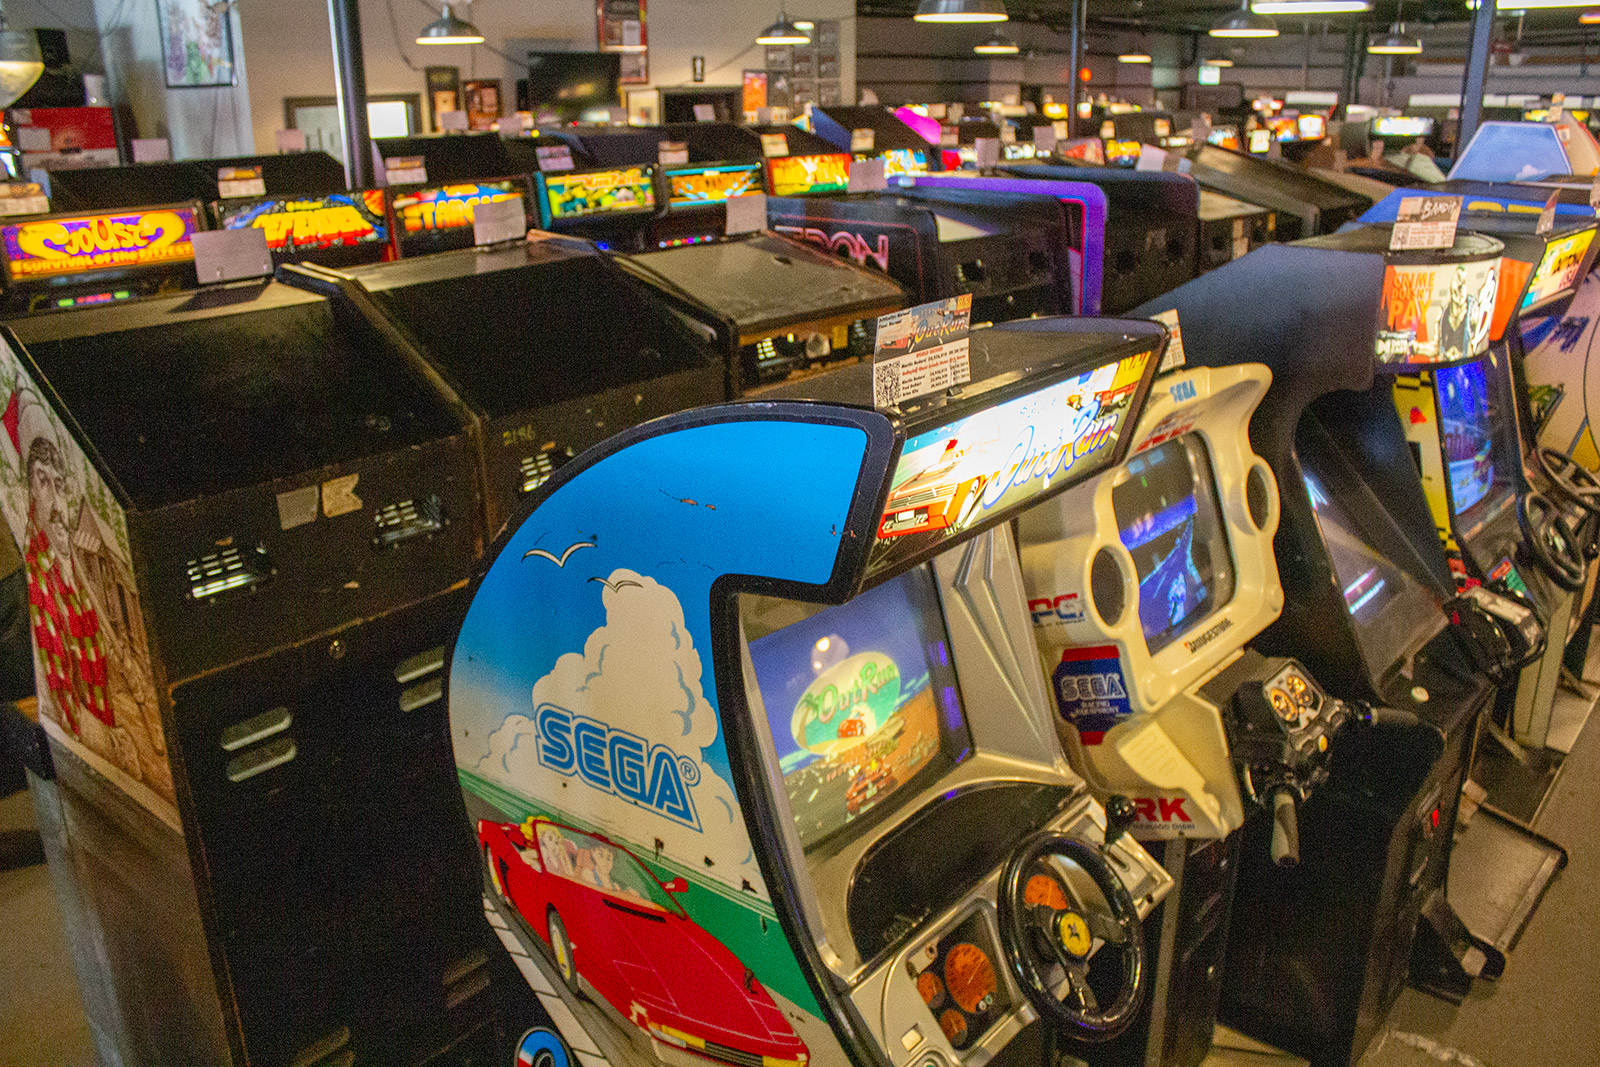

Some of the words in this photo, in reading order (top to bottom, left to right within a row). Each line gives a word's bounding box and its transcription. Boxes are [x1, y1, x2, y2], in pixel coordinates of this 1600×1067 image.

[21, 254, 94, 272] SURVIVAL
[1388, 299, 1431, 324] PAY
[1169, 380, 1197, 402] SEGA
[1061, 673, 1127, 701] SEGA
[1132, 798, 1192, 822] RK
